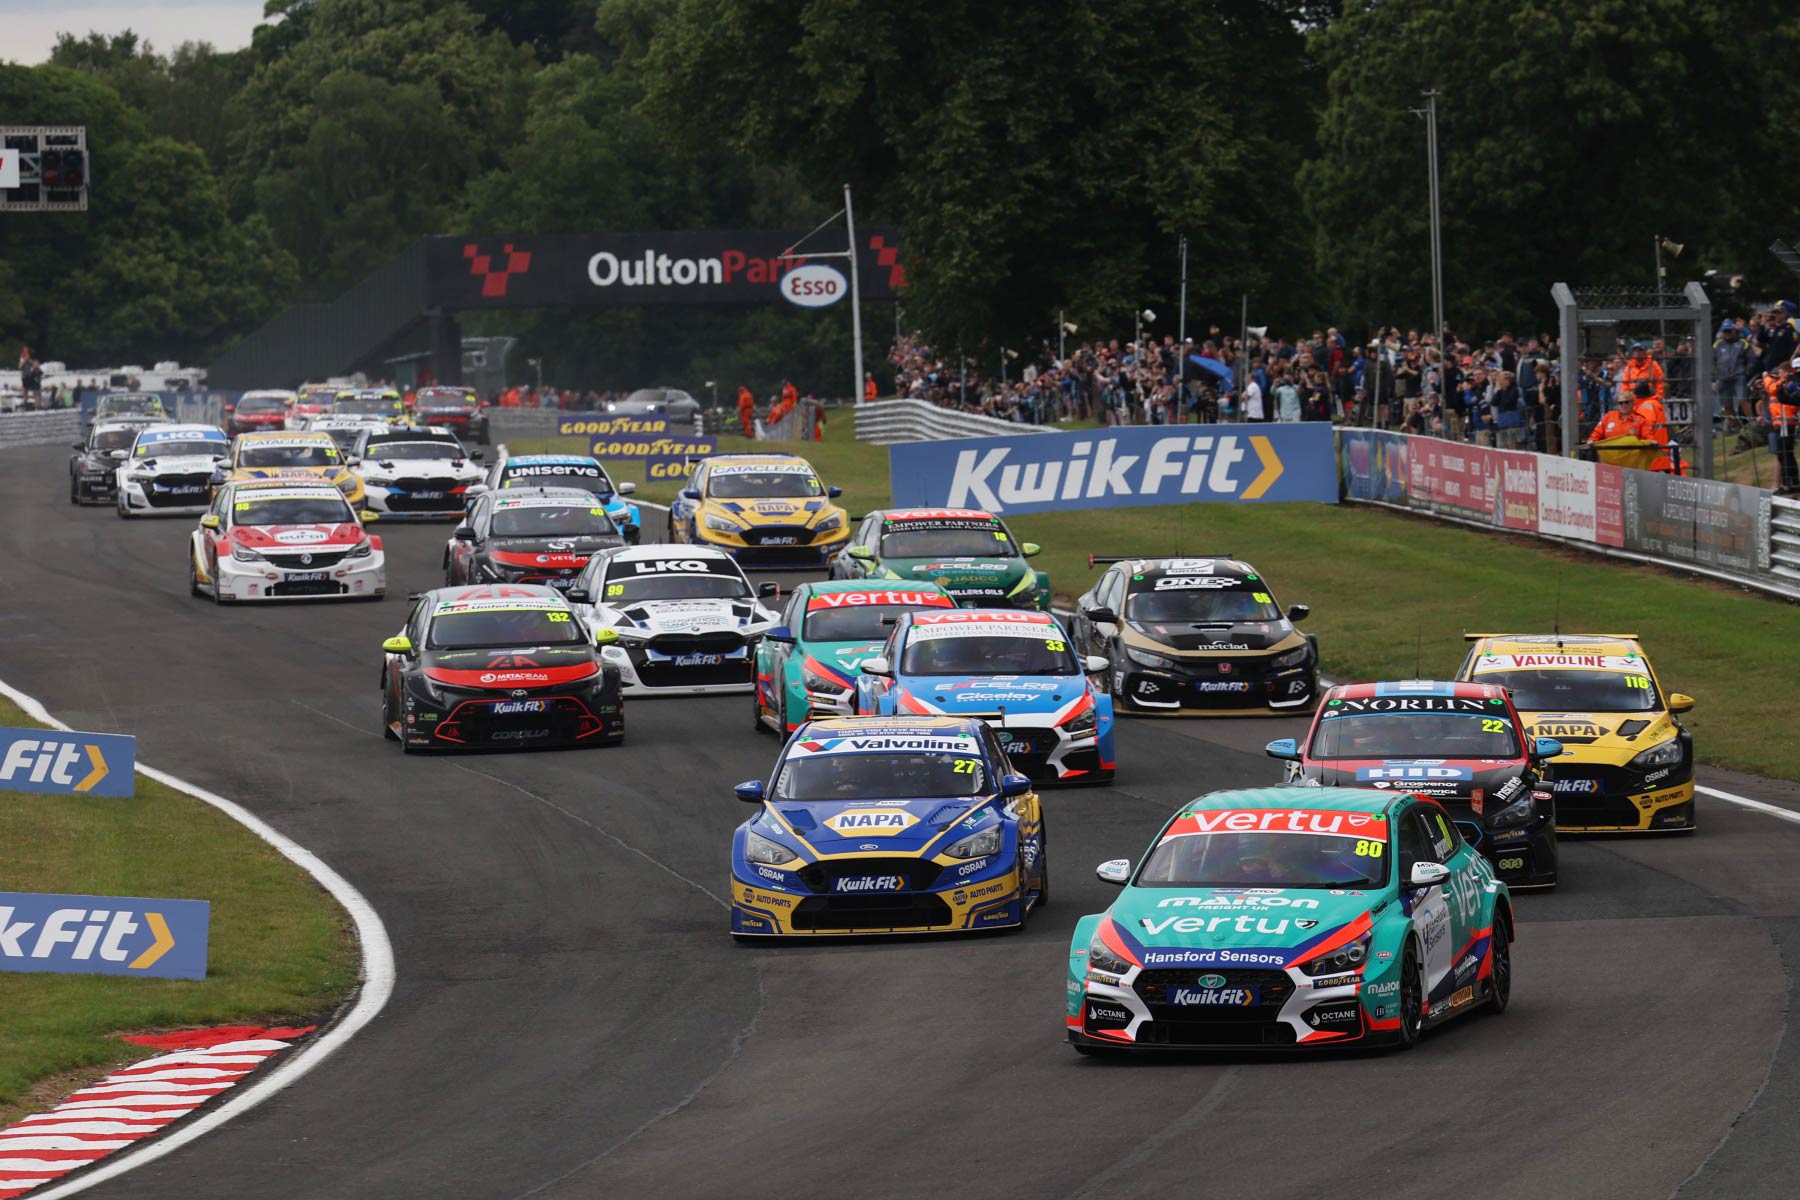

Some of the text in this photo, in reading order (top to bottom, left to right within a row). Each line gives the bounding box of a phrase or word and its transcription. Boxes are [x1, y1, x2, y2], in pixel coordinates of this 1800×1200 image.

[791, 277, 836, 296] Esso
[560, 417, 666, 435] GOODYEAR
[156, 432, 204, 441] LKQ
[713, 465, 808, 474] CATACLEAN
[756, 503, 793, 512] NAPA
[635, 560, 711, 573] LKQ
[607, 584, 624, 596] 99
[820, 590, 924, 607] vertu
[546, 612, 570, 623] 132
[921, 612, 1028, 623] vertu
[1045, 640, 1065, 652] 33
[1198, 641, 1249, 650] metclad
[1511, 654, 1606, 668] VALVOLINE
[1624, 676, 1649, 689] 116
[1341, 698, 1485, 712] NORLIN
[1482, 719, 1504, 733] 22
[1539, 723, 1595, 736] NAPA
[850, 739, 970, 752] Valvoline
[953, 759, 976, 774] 27
[1368, 768, 1462, 778] HID
[1644, 768, 1669, 784] OSRAM
[839, 814, 904, 828] NAPA
[1193, 810, 1342, 833] vertu
[1355, 840, 1383, 859] 80
[958, 858, 987, 876] OSRAM
[758, 866, 785, 883] OSRAM
[970, 883, 1004, 900] AUTO PARTS
[756, 894, 792, 909] AUTO PARTS
[1142, 914, 1290, 936] vertu
[1144, 950, 1284, 966] Hansford Sensors
[1318, 976, 1361, 987] GOODYEAR
[1097, 1009, 1127, 1020] OCTANE
[1321, 1010, 1356, 1020] OCTANE
